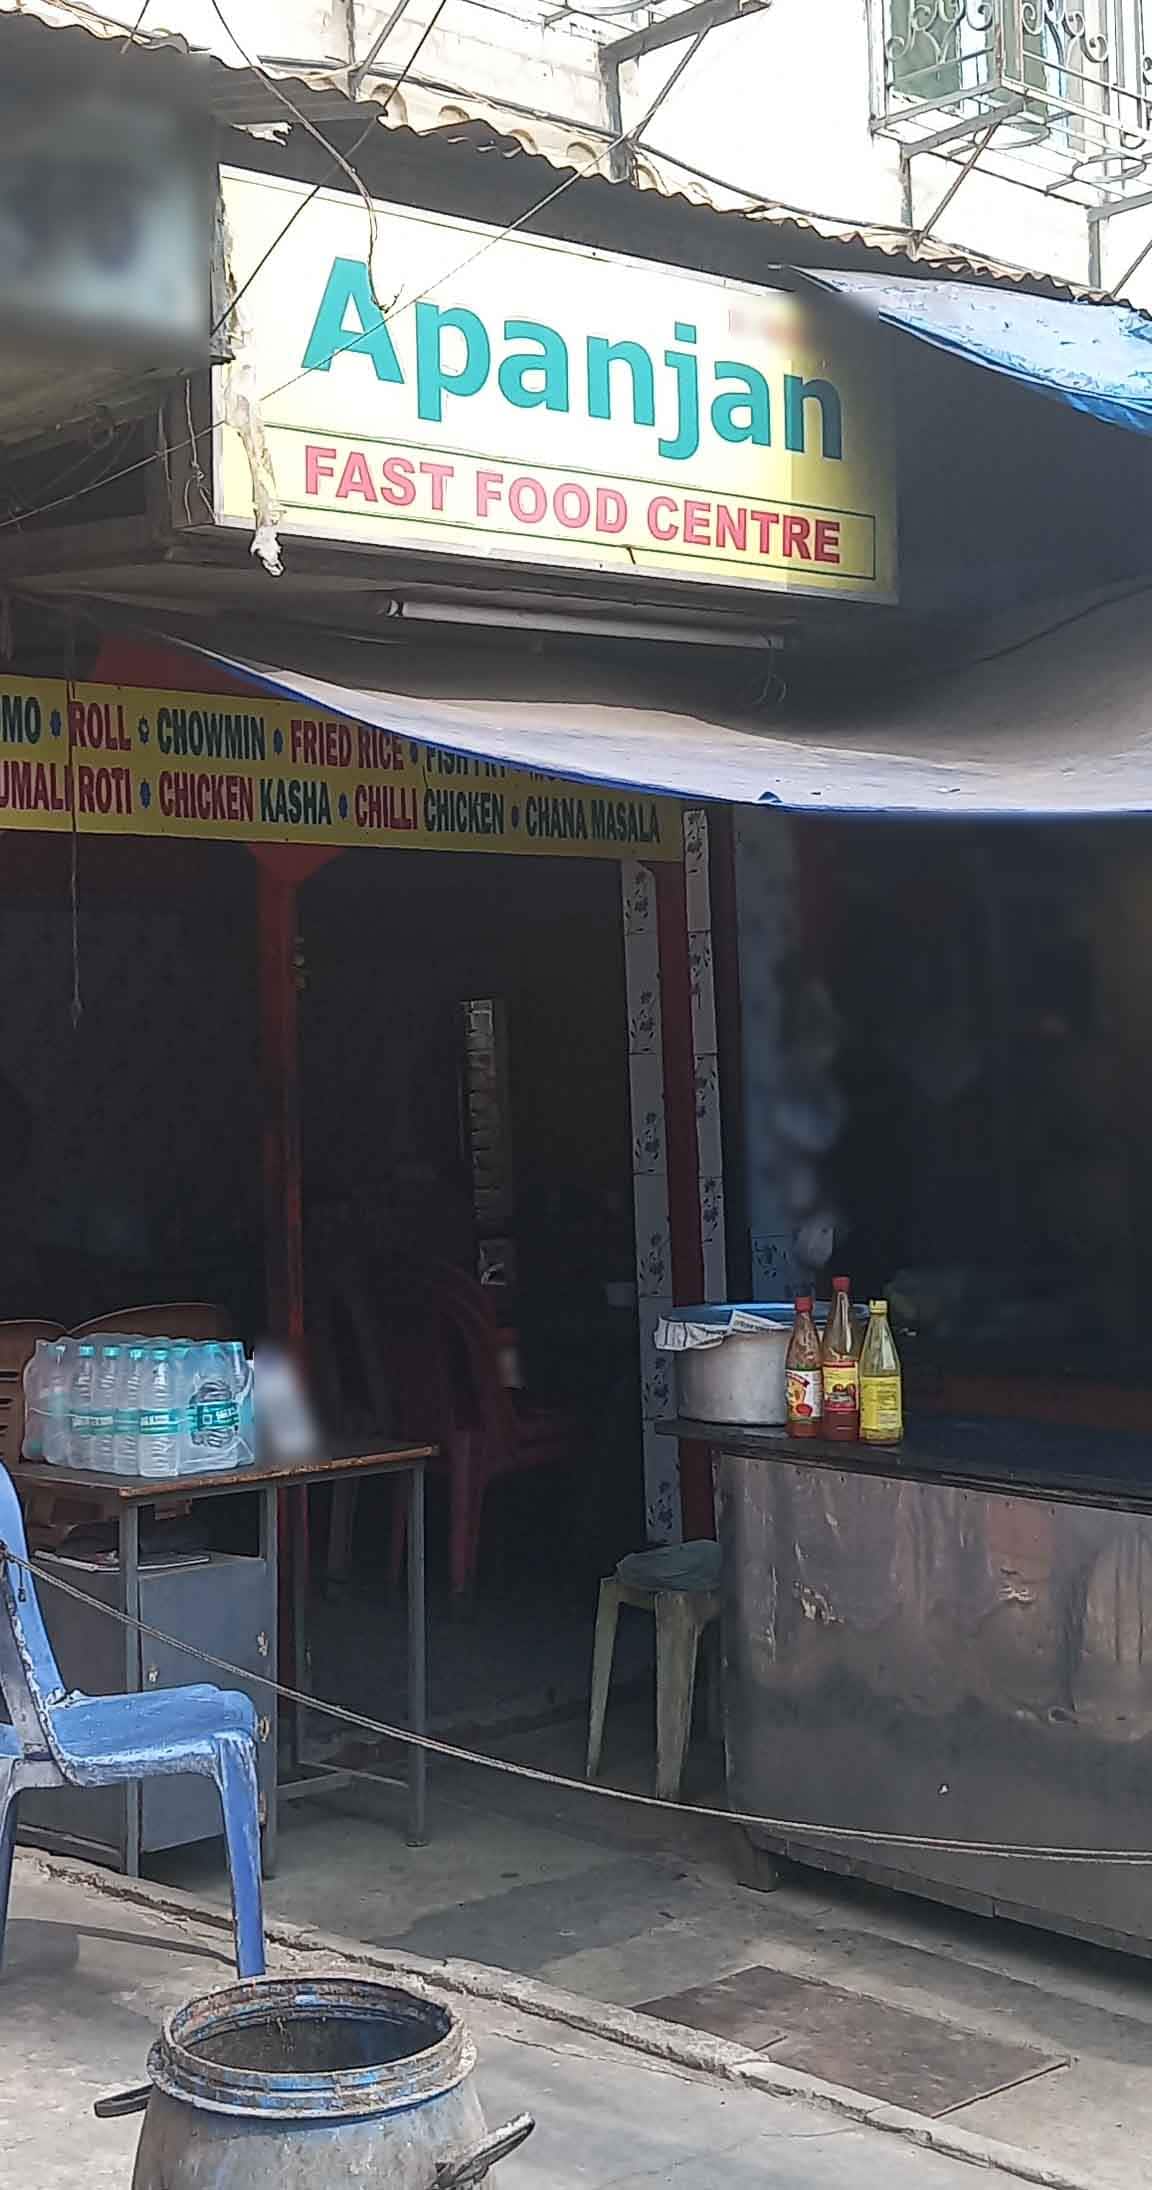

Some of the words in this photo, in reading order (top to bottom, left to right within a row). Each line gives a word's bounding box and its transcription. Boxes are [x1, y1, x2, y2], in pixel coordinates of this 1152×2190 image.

[301, 256, 843, 461] Apanjan
[305, 445, 454, 510] FAST
[476, 470, 628, 534] FOOD
[646, 496, 841, 564] CENTRE
[69, 701, 131, 750] ROLL
[157, 707, 265, 760] CHOWMIN
[290, 719, 351, 767] FRIED
[358, 726, 404, 770] RICE
[79, 765, 132, 814] ROTI
[159, 770, 254, 822] CHICKEN
[259, 778, 332, 825] KASHA
[354, 784, 418, 830] CHILLI
[424, 788, 504, 834] CHICKEN
[525, 795, 587, 840] CHANA
[592, 802, 660, 843] MASALA
